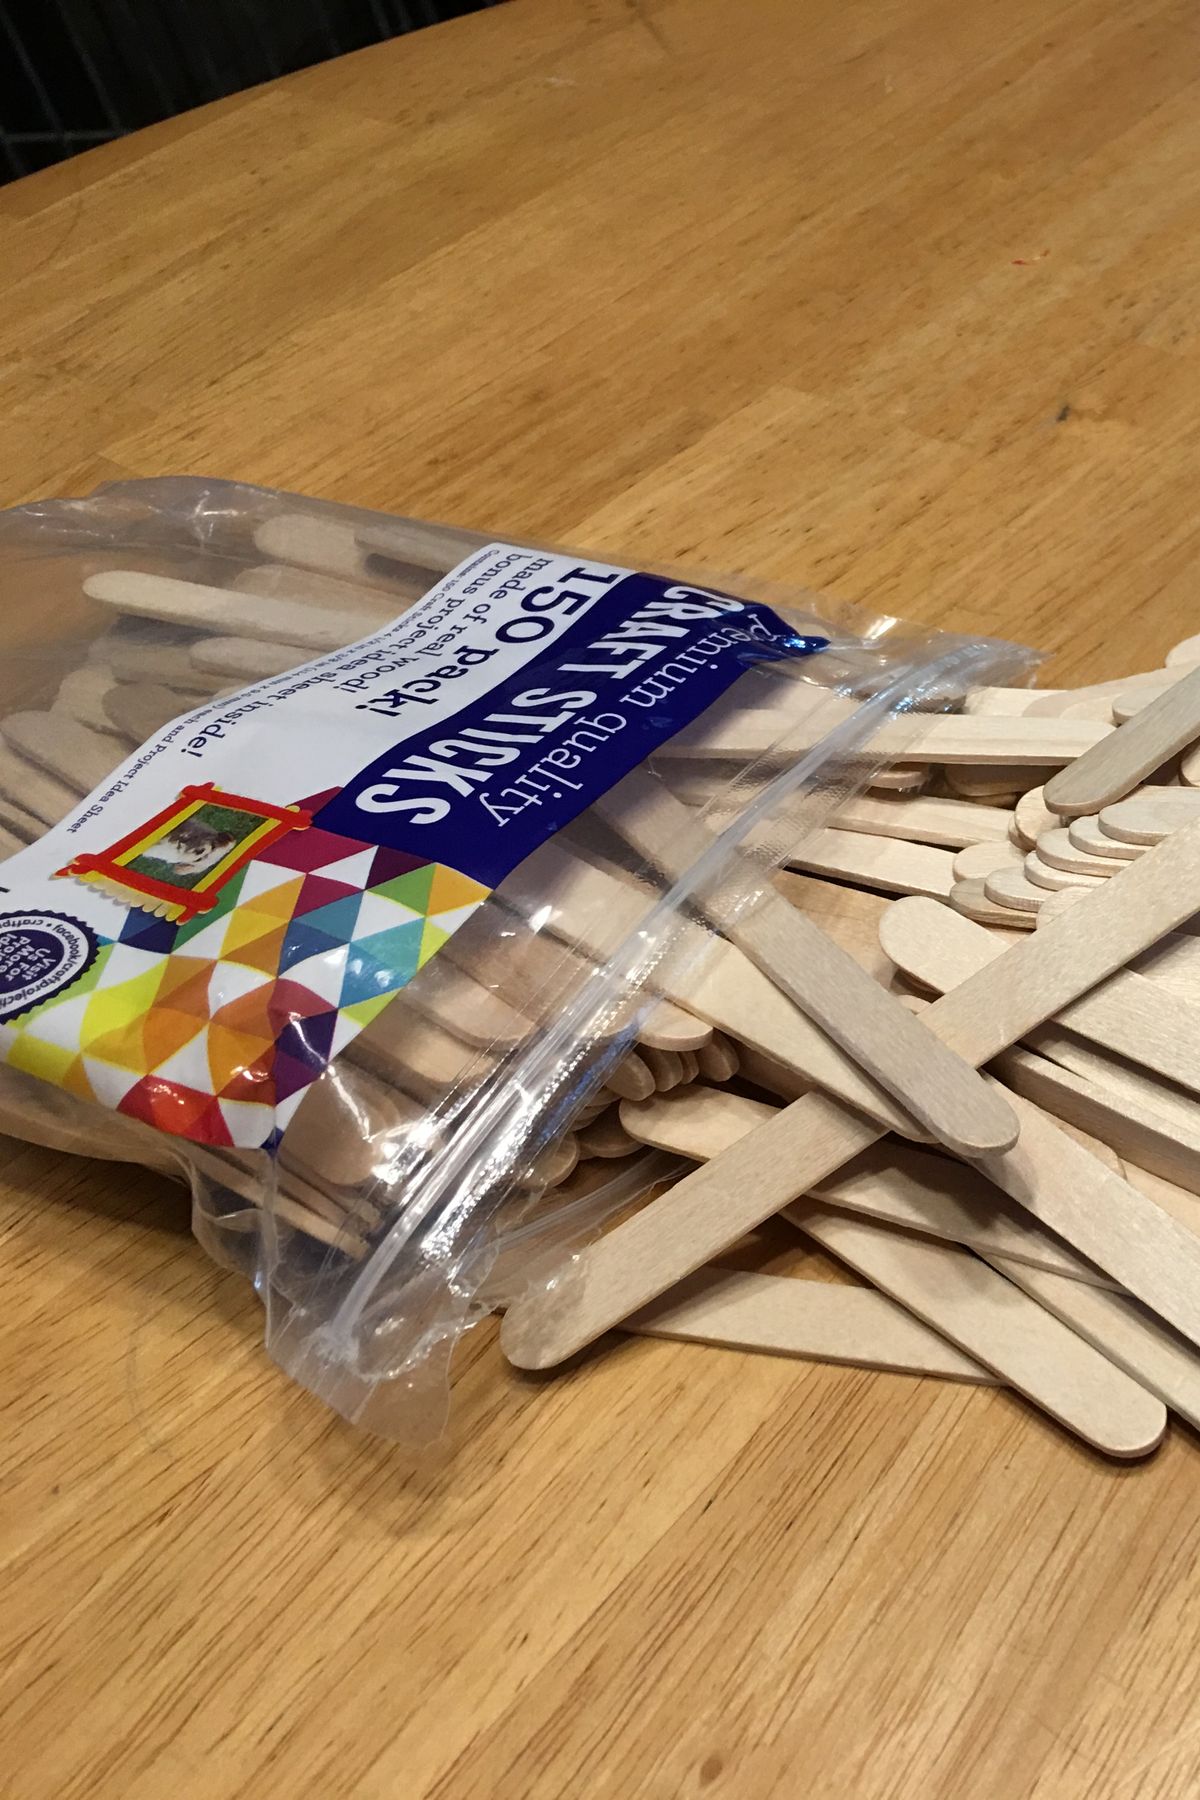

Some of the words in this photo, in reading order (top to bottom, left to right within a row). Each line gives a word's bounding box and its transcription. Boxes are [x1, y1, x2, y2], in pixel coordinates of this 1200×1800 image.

[462, 553, 533, 594] bonus
[489, 558, 553, 599] made
[463, 603, 491, 624] of
[495, 567, 621, 643] 150
[389, 598, 466, 649] project
[415, 625, 468, 656] real
[557, 586, 745, 679] CRAFT
[333, 656, 420, 693] wood!
[336, 649, 396, 670] idea
[267, 672, 337, 700] sheet
[355, 645, 500, 717] pack!
[162, 725, 185, 743] and
[181, 701, 273, 757] inside!
[123, 744, 167, 780] Project
[355, 687, 598, 824] STICKS
[479, 712, 627, 827] quality
[99, 780, 129, 803] Idea
[66, 805, 104, 834] Sheet
[5, 962, 30, 982] For
[22, 958, 56, 980] Visit
[27, 948, 51, 961] Us
